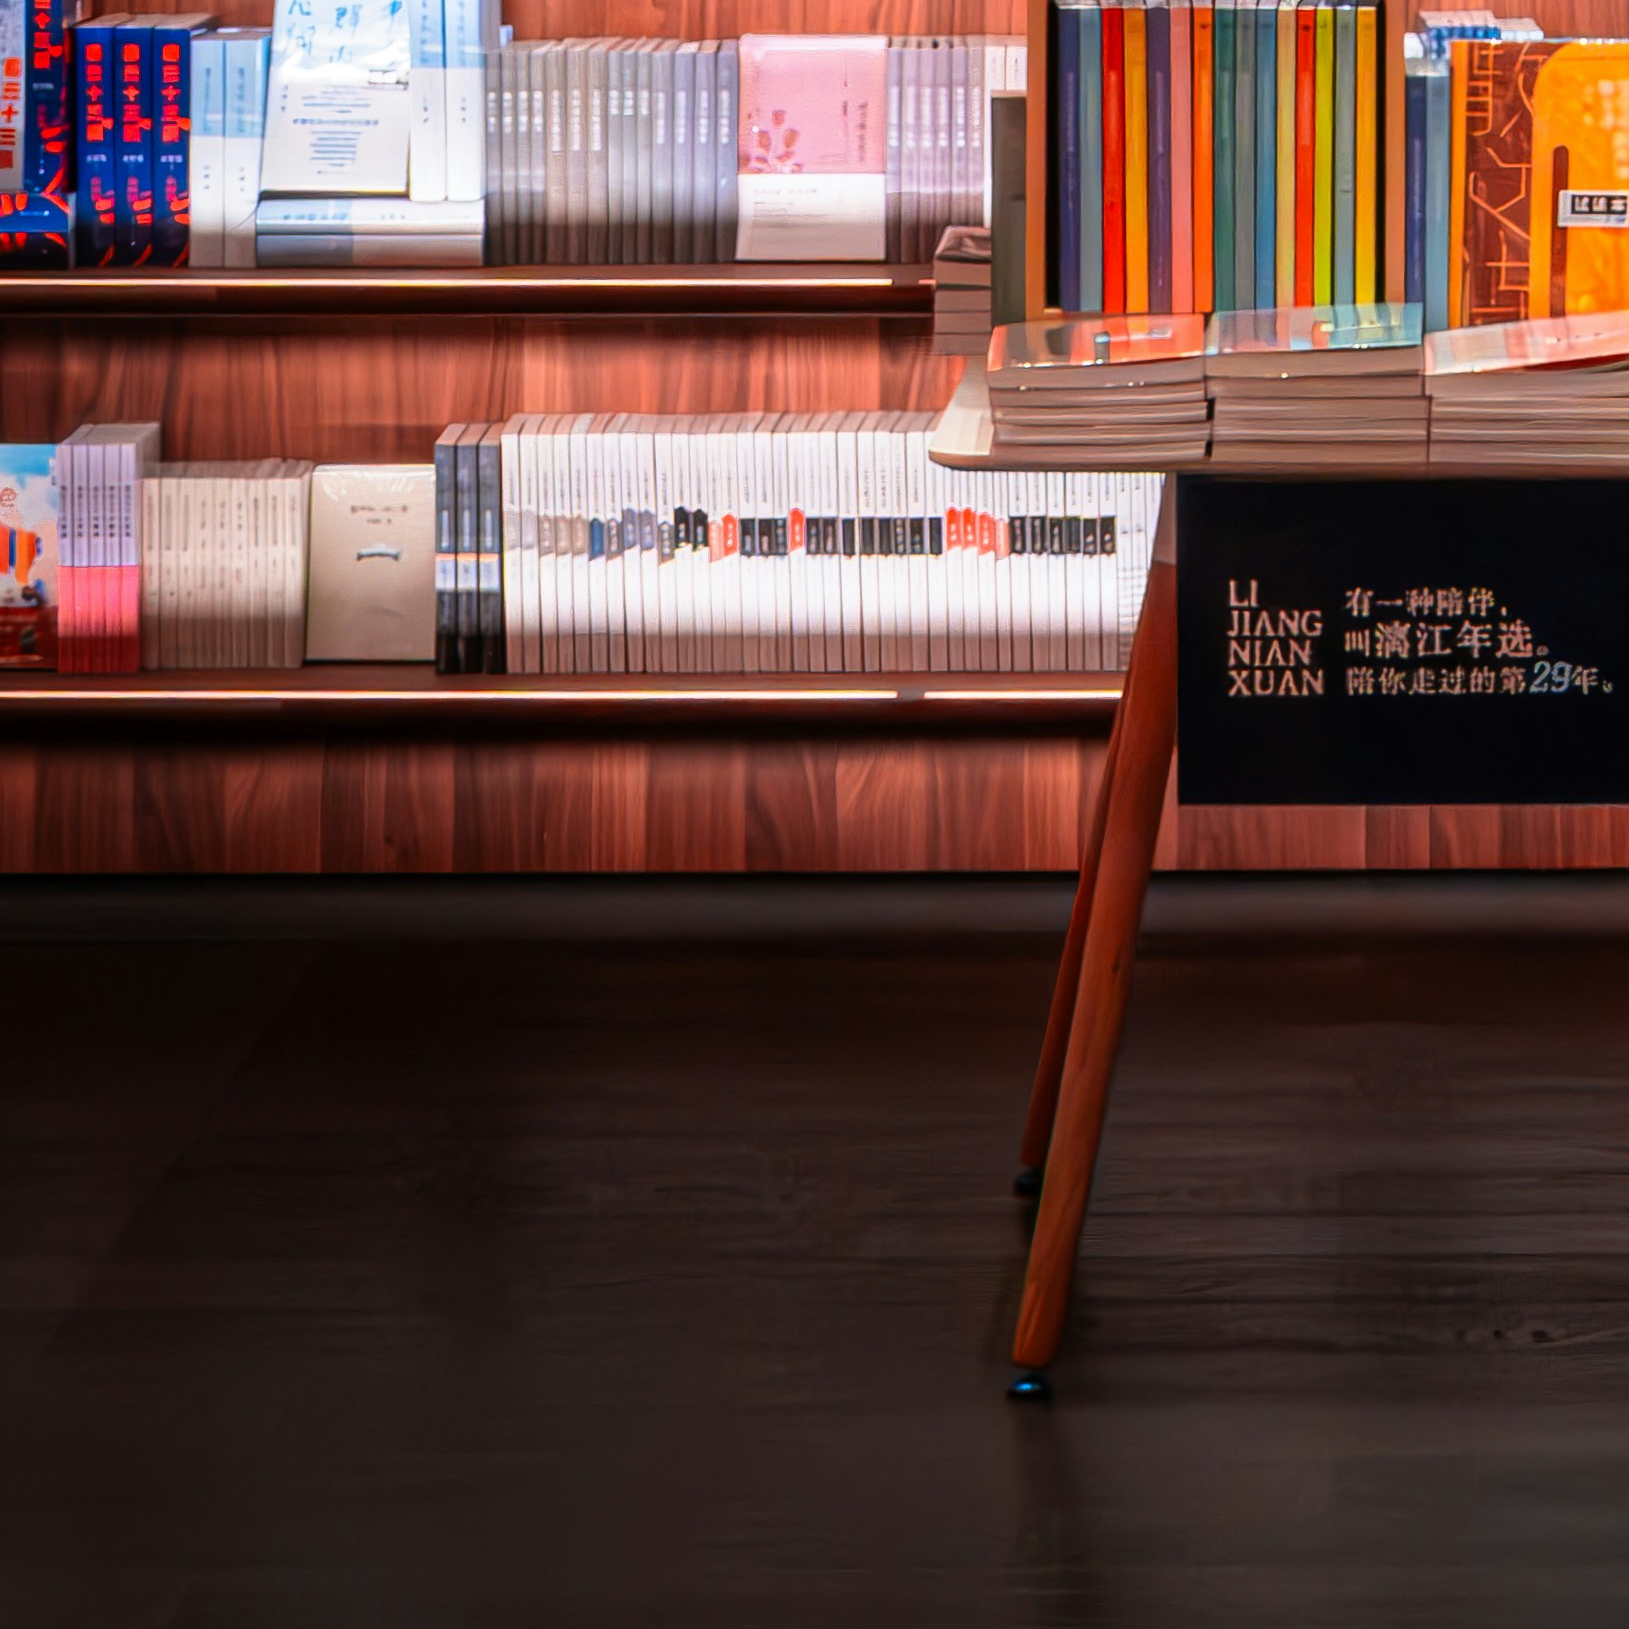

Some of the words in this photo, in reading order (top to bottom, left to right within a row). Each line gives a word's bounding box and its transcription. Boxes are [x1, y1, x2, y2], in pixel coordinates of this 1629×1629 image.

[1229, 579, 1259, 608] LI
[1345, 586, 1507, 618] 有一种陪伴，
[1226, 609, 1323, 638] JIANG
[1228, 638, 1312, 667] NIAN
[1344, 619, 1549, 660] 叫漓江年选。
[1228, 668, 1324, 697] XUAN
